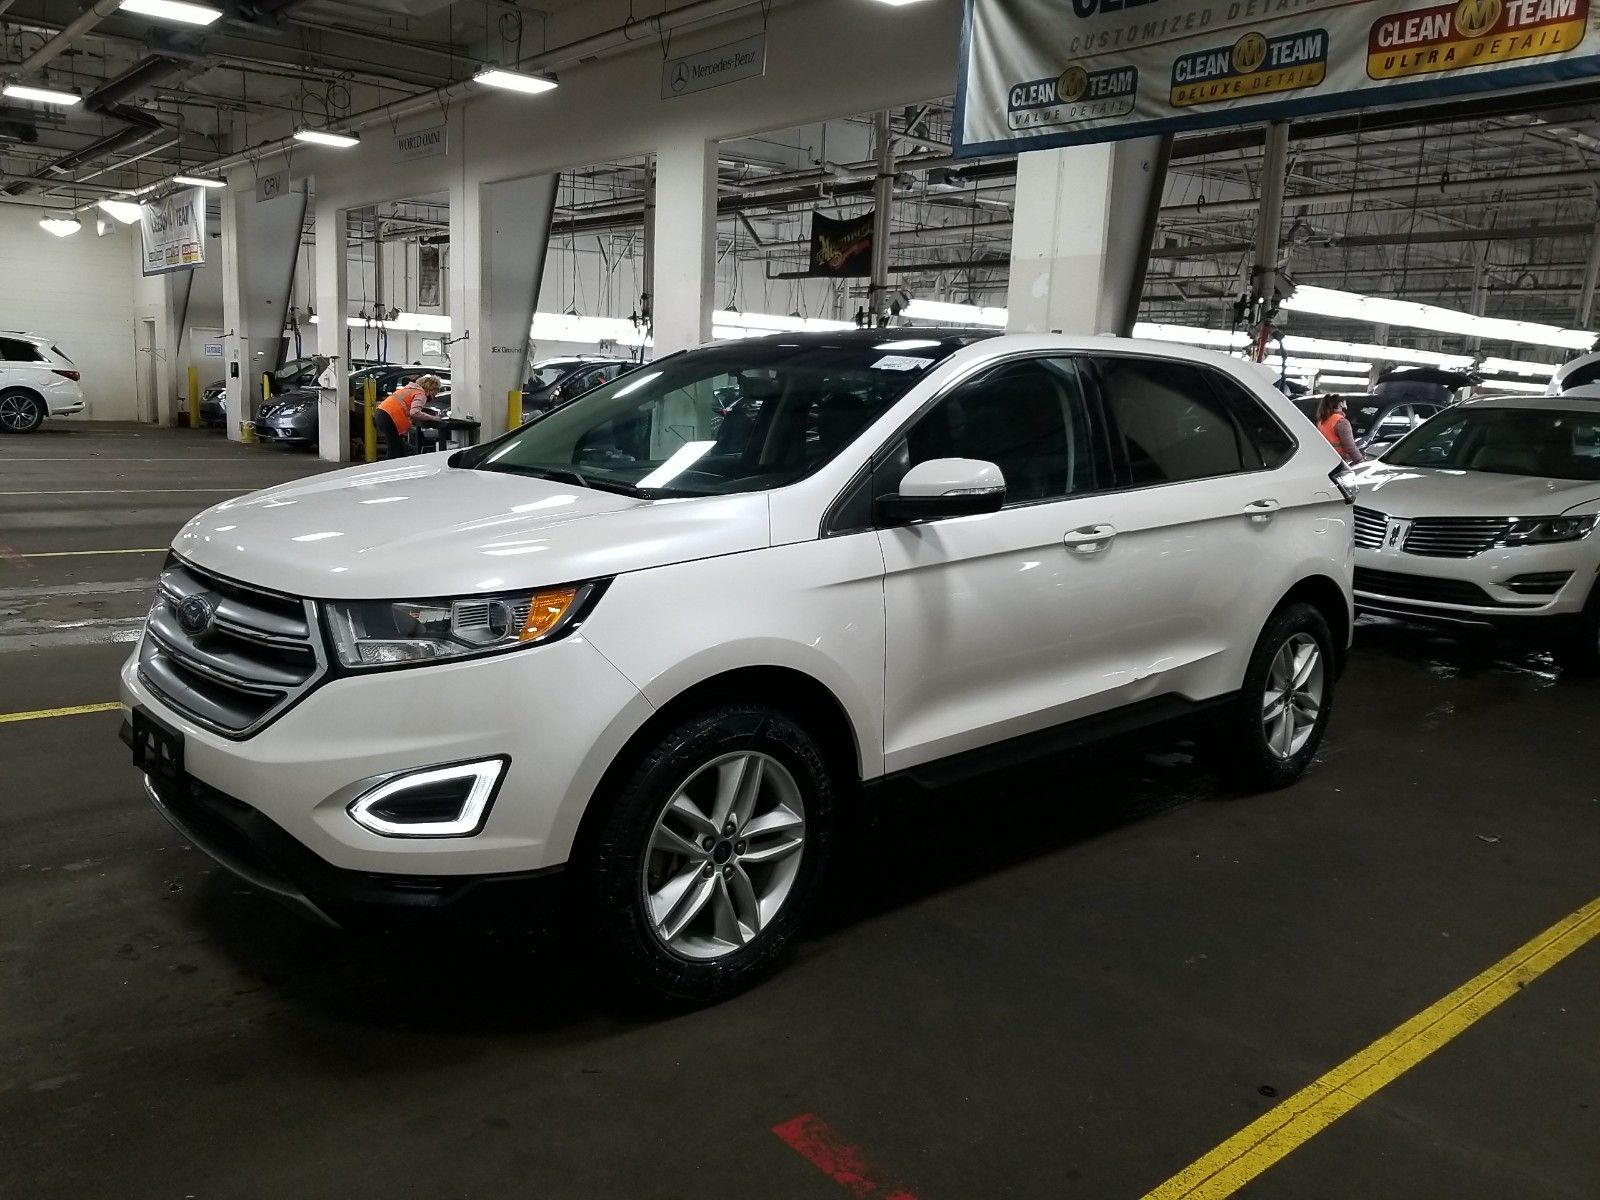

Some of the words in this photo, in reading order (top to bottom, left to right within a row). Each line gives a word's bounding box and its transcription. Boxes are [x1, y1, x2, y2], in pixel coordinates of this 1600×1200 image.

[1070, 9, 1212, 53] CUSTOMIZED
[1378, 12, 1451, 48] CLEAN
[1506, 0, 1577, 27] TEAM
[692, 51, 755, 78] Mercedes-Benz
[1175, 51, 1230, 82] CLEAN
[1270, 34, 1322, 65] TEAM
[1384, 47, 1455, 70] ULTRA
[1473, 29, 1562, 57] DETAIL
[1011, 84, 1056, 107] CLEAN
[1089, 70, 1133, 97] TEAM
[1178, 83, 1241, 100] DELUXE
[1253, 68, 1316, 90] DETAIL
[1015, 109, 1061, 125] VALUE
[1071, 101, 1125, 117] DETAIL
